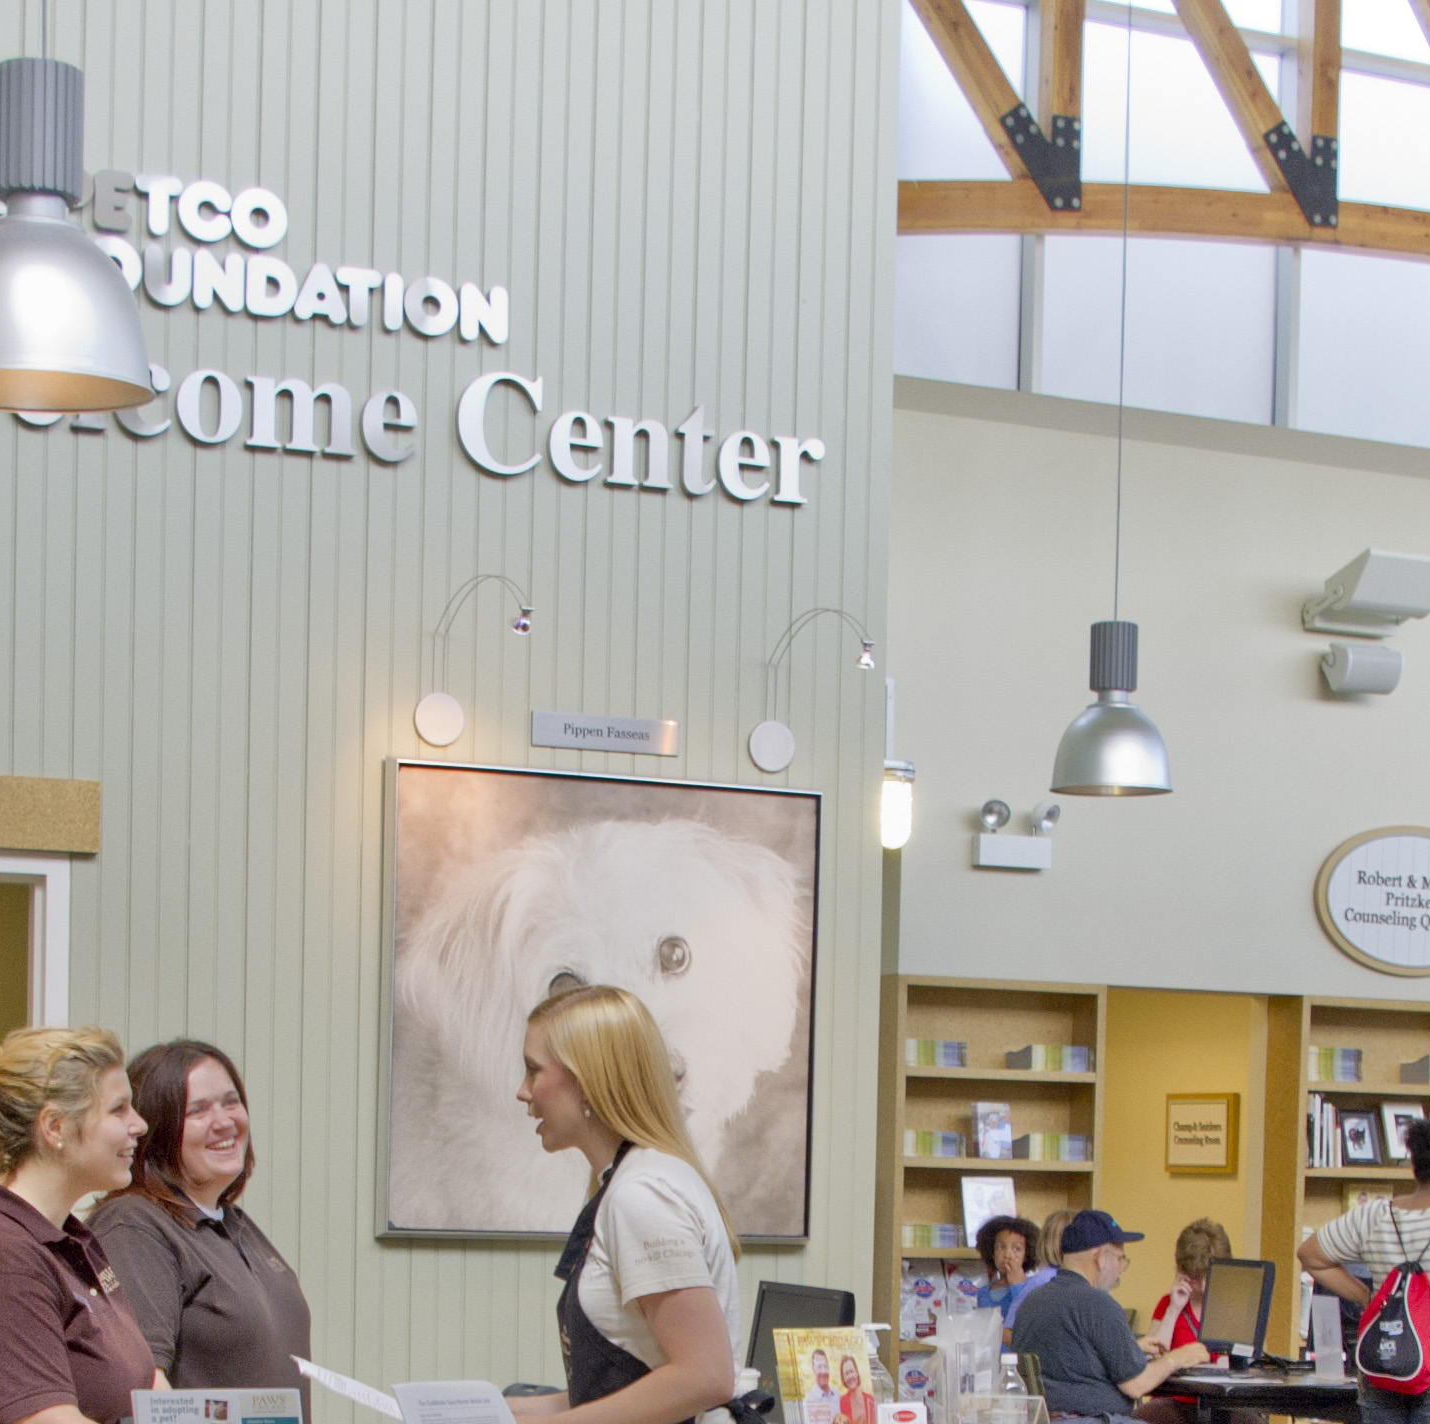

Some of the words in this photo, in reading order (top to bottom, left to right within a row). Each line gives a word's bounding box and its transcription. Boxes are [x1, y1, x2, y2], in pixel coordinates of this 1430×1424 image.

[83, 167, 288, 250] ETCO
[94, 234, 510, 346] OUNDATION
[456, 371, 826, 506] Center
[563, 722, 604, 740] Pippen
[607, 725, 651, 741] Fasseas
[1357, 870, 1402, 888] Robert
[1406, 875, 1417, 889] &
[1344, 908, 1417, 930] Counseling
[643, 1237, 679, 1250] Building
[150, 1397, 194, 1406] Interested
[252, 1395, 287, 1405] PAWS
[151, 1406, 159, 1414] in
[162, 1406, 200, 1416] adopting
[159, 1414, 177, 1424] pet?
